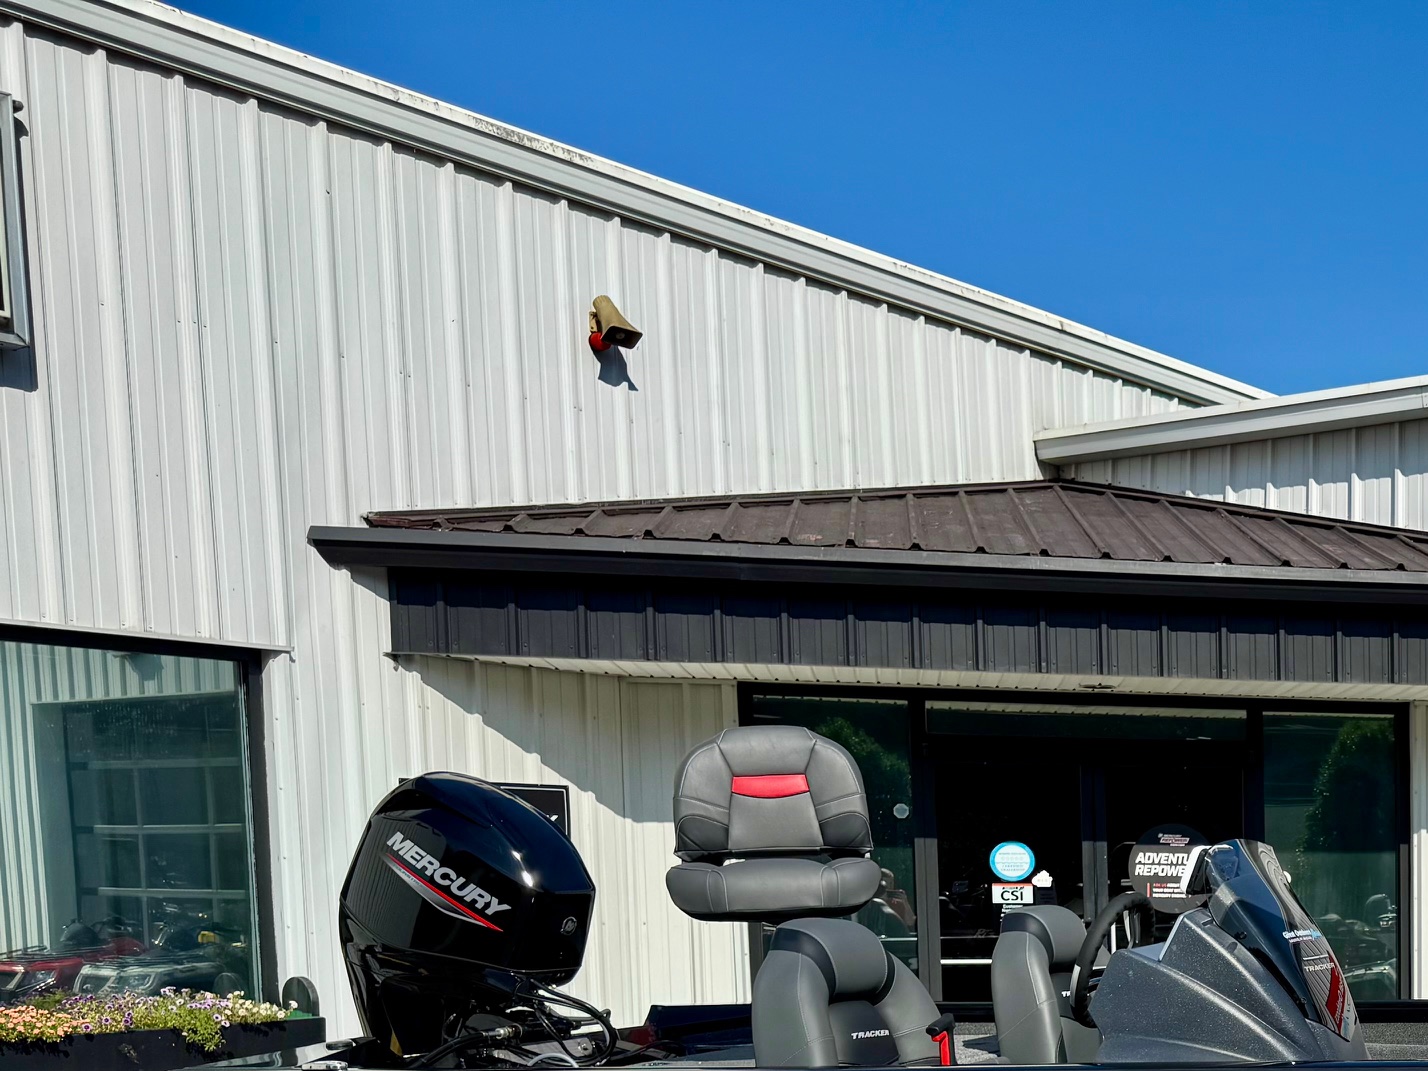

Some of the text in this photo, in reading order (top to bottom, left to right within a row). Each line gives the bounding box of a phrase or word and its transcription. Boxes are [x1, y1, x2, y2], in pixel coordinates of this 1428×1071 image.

[1135, 852, 1189, 865] ADVENTU
[386, 831, 512, 916] MERCURY
[1134, 864, 1187, 877] REPOWE
[1304, 962, 1335, 972] TRACKER
[850, 1029, 890, 1040] TRACKER
